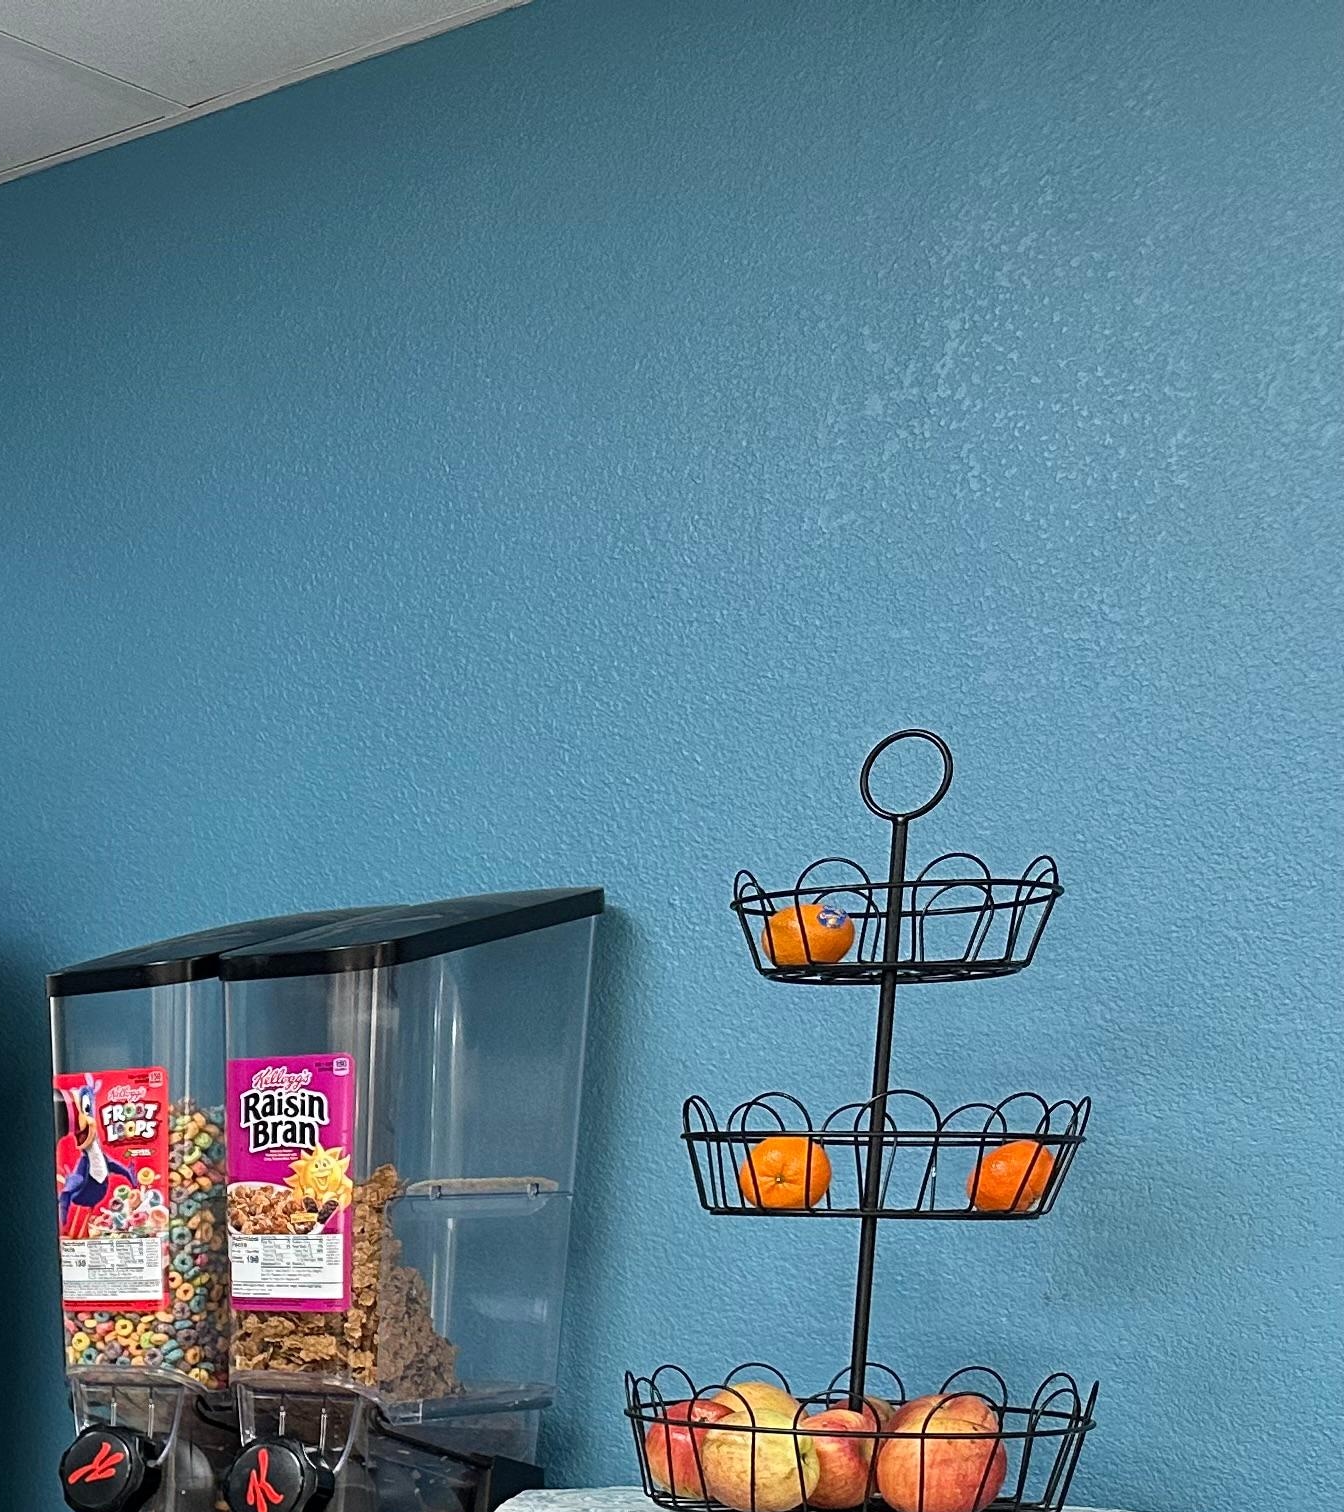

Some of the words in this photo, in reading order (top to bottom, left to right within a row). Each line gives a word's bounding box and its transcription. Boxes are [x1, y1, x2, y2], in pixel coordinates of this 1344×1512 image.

[254, 1068, 310, 1089] Kellogg's
[101, 1102, 159, 1126] FROOT
[243, 1091, 326, 1124] Raisin
[106, 1120, 158, 1141] LOOPS
[252, 1120, 317, 1149] Bran
